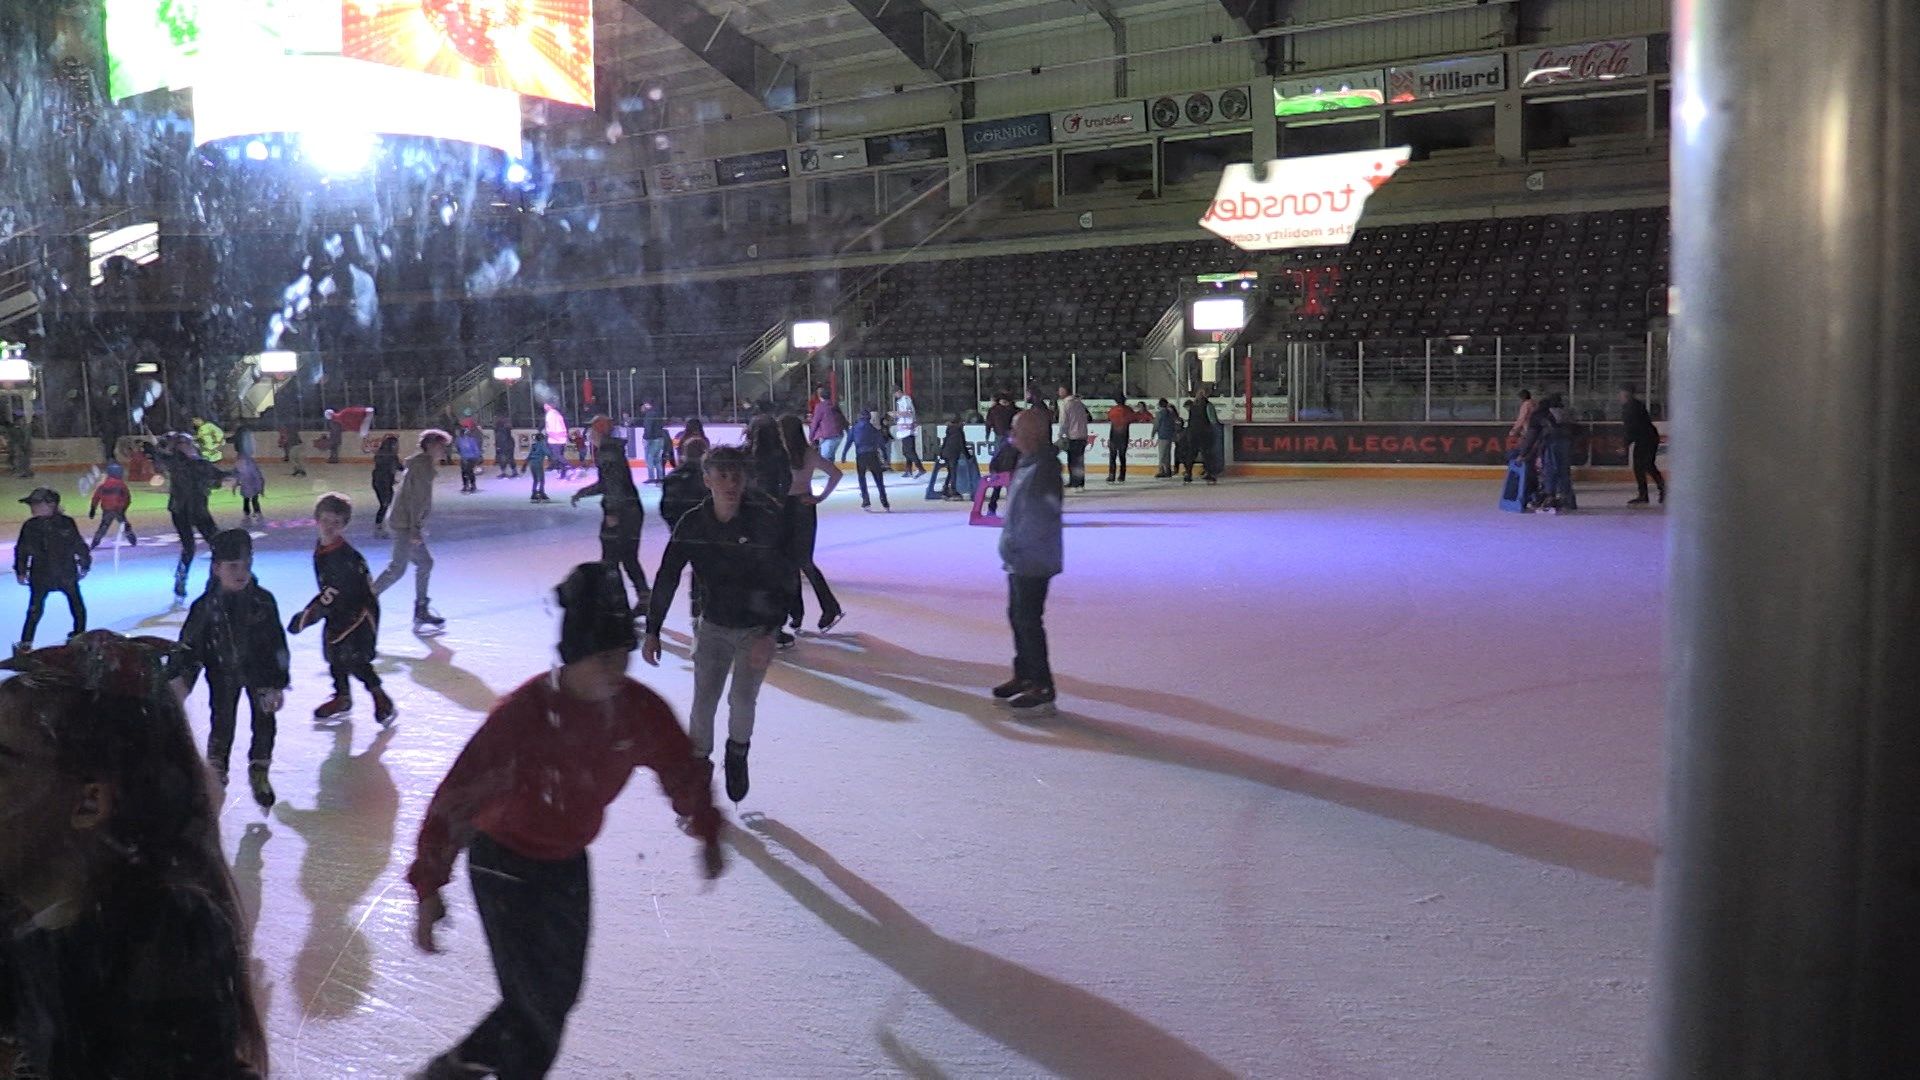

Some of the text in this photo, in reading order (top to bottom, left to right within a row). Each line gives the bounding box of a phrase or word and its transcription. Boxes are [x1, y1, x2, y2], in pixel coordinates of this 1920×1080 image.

[1419, 66, 1500, 93] Hilliard
[973, 122, 1040, 144] CORNING
[1241, 434, 1339, 453] ELMIRA
[1347, 434, 1456, 453] LEGACY
